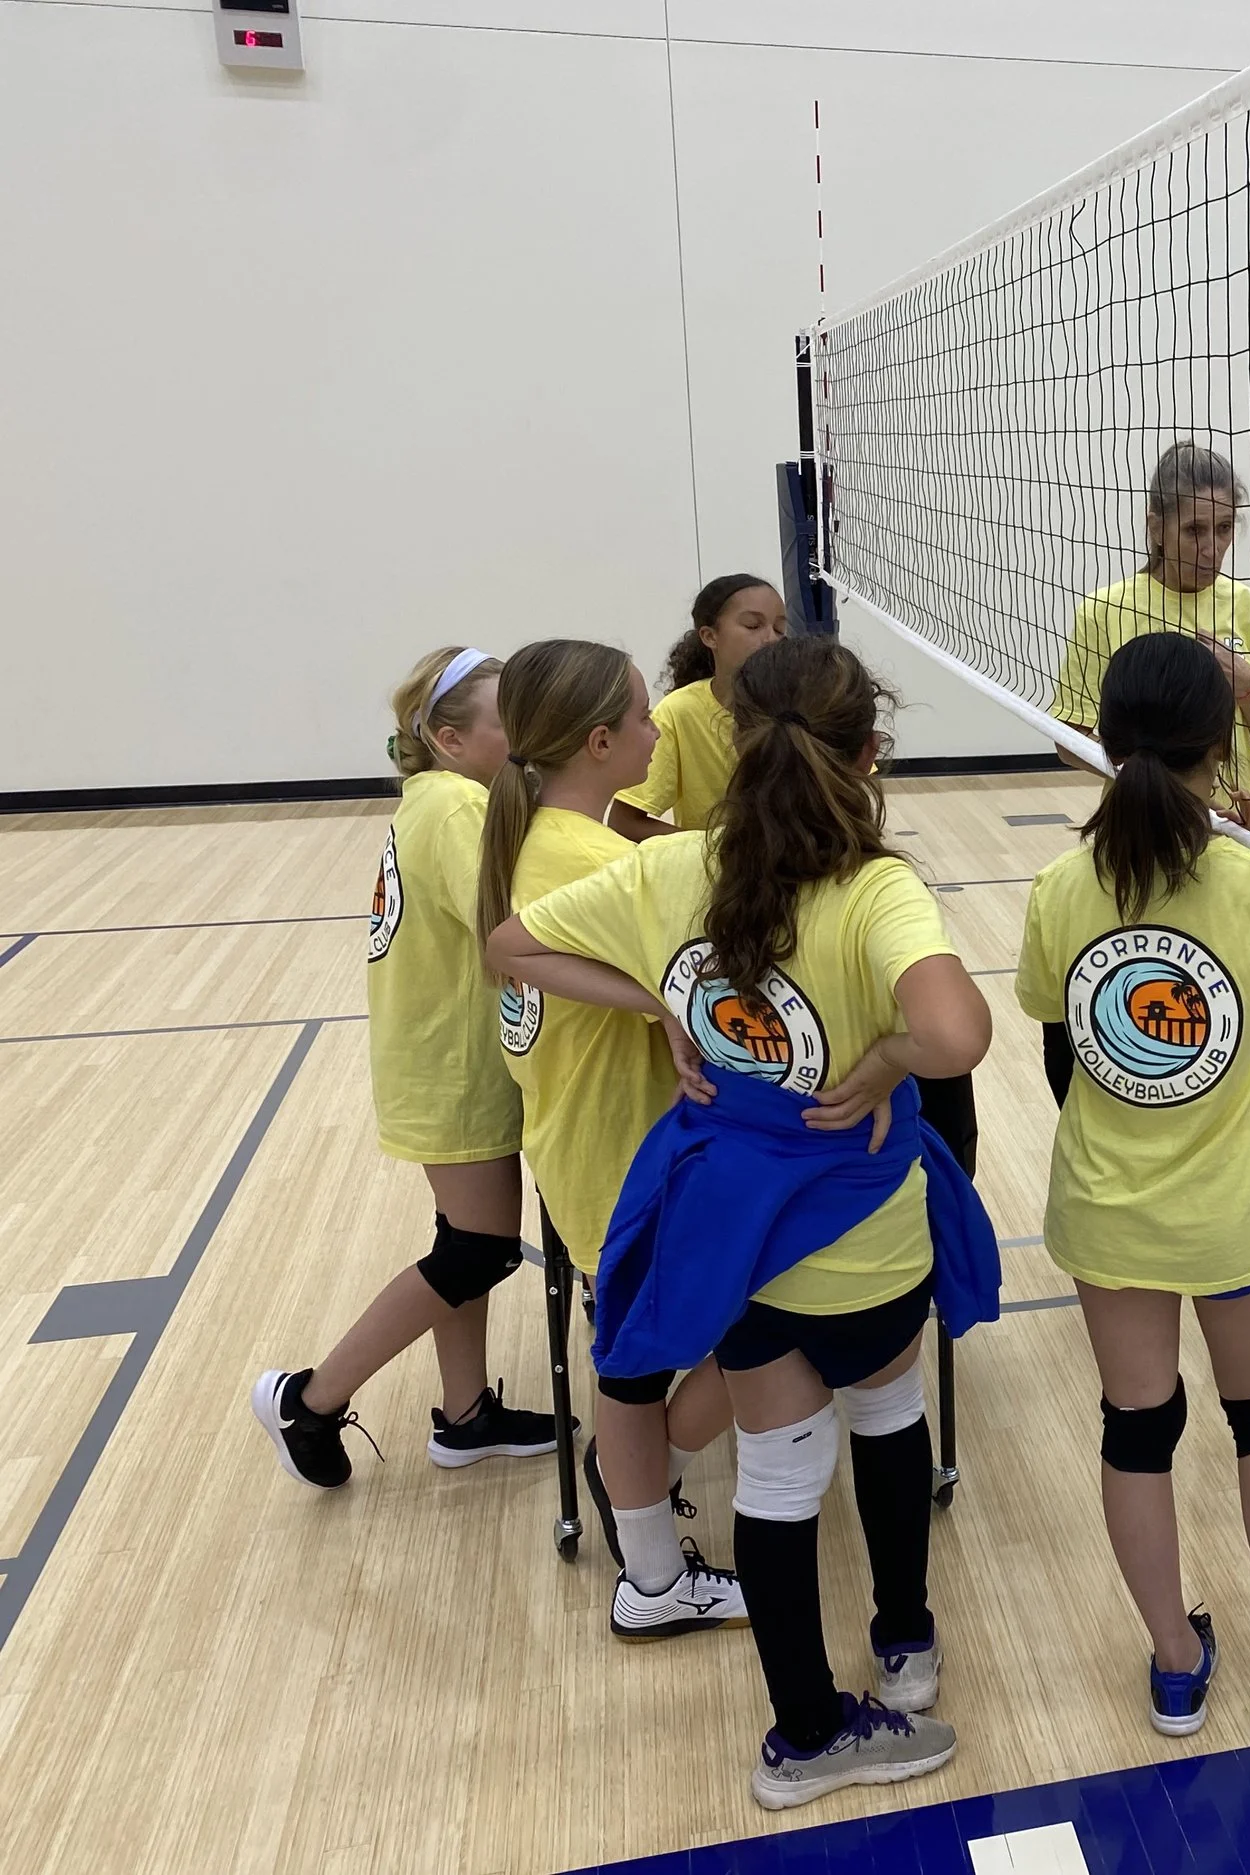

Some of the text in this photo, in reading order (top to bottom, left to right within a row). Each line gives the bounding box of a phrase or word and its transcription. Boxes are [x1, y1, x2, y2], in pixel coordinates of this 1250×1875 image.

[245, 30, 256, 47] 6
[1074, 934, 1230, 999] TORRANCE
[1077, 1037, 1228, 1100] VOLLEYBALL CLUB
